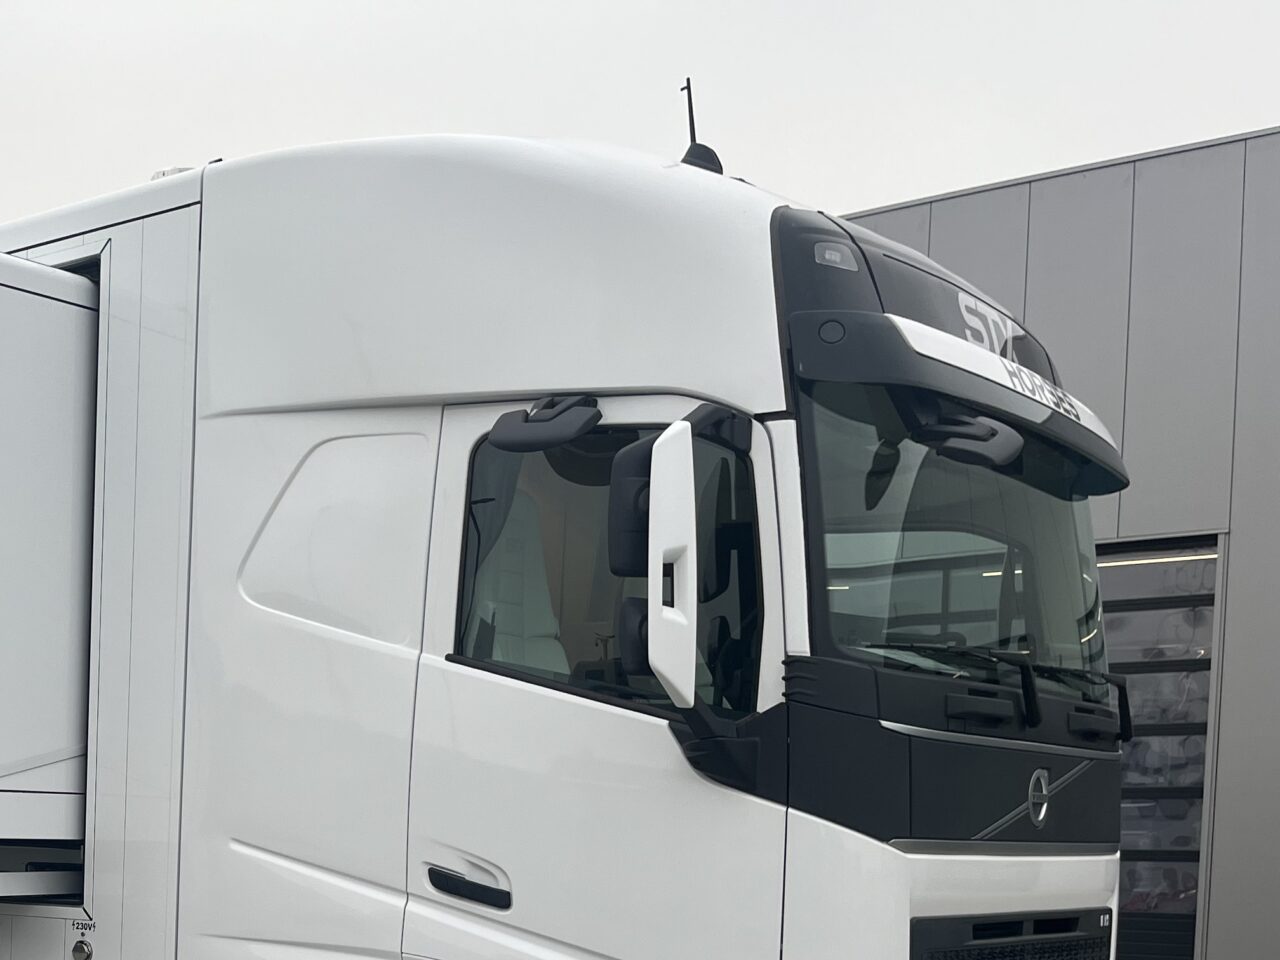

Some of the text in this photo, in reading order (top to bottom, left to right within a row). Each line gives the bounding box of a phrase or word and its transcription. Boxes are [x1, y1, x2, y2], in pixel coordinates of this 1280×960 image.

[958, 291, 1025, 365] STX
[999, 357, 1081, 421] HORSES
[75, 922, 93, 931] 230V
